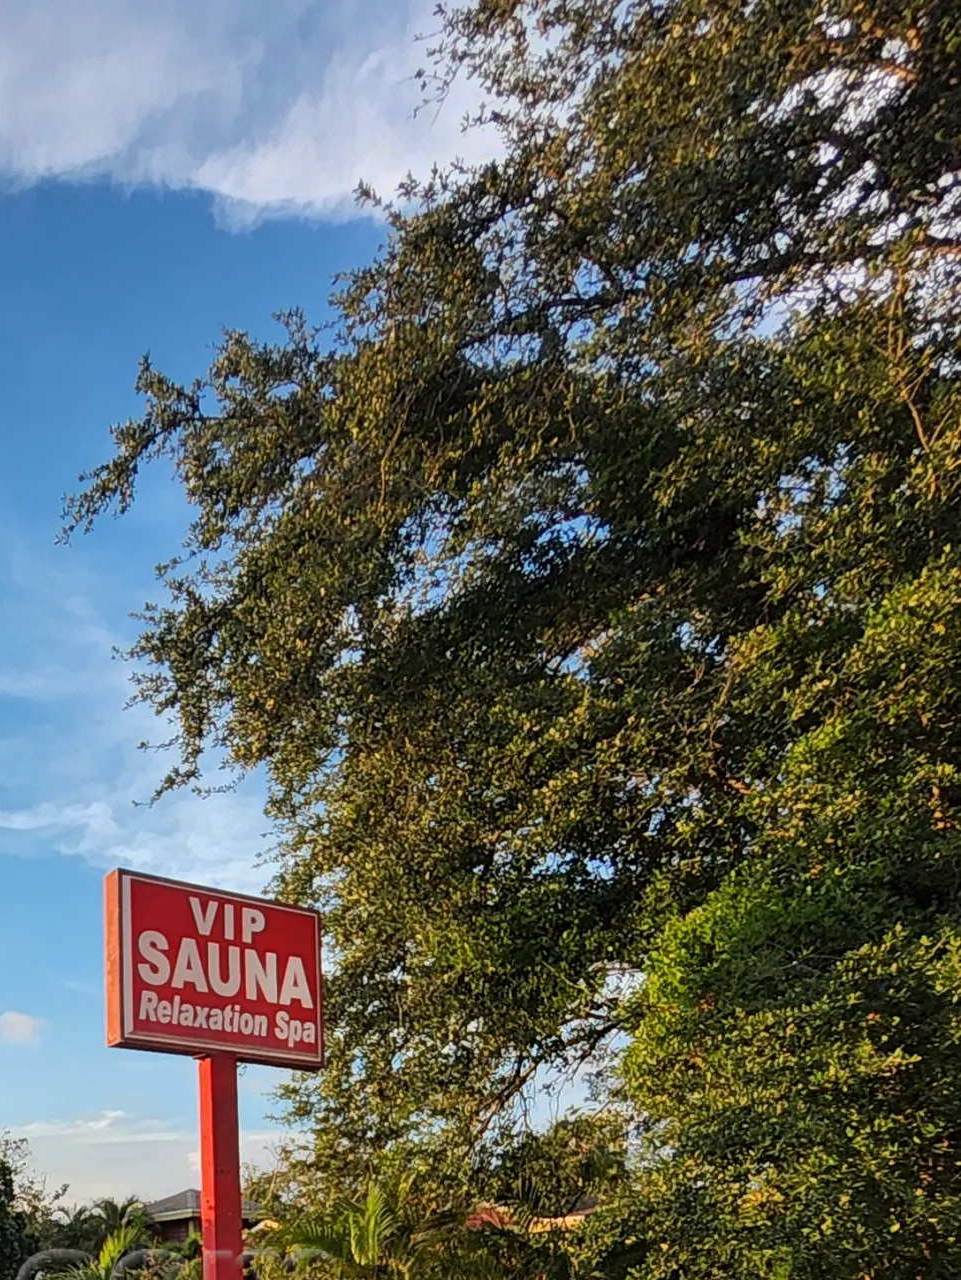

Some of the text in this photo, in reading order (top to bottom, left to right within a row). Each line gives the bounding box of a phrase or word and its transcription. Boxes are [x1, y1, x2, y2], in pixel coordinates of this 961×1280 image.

[189, 896, 266, 944] VIP
[137, 930, 314, 1009] SAUNA
[138, 990, 316, 1047] Relaxation Spa
